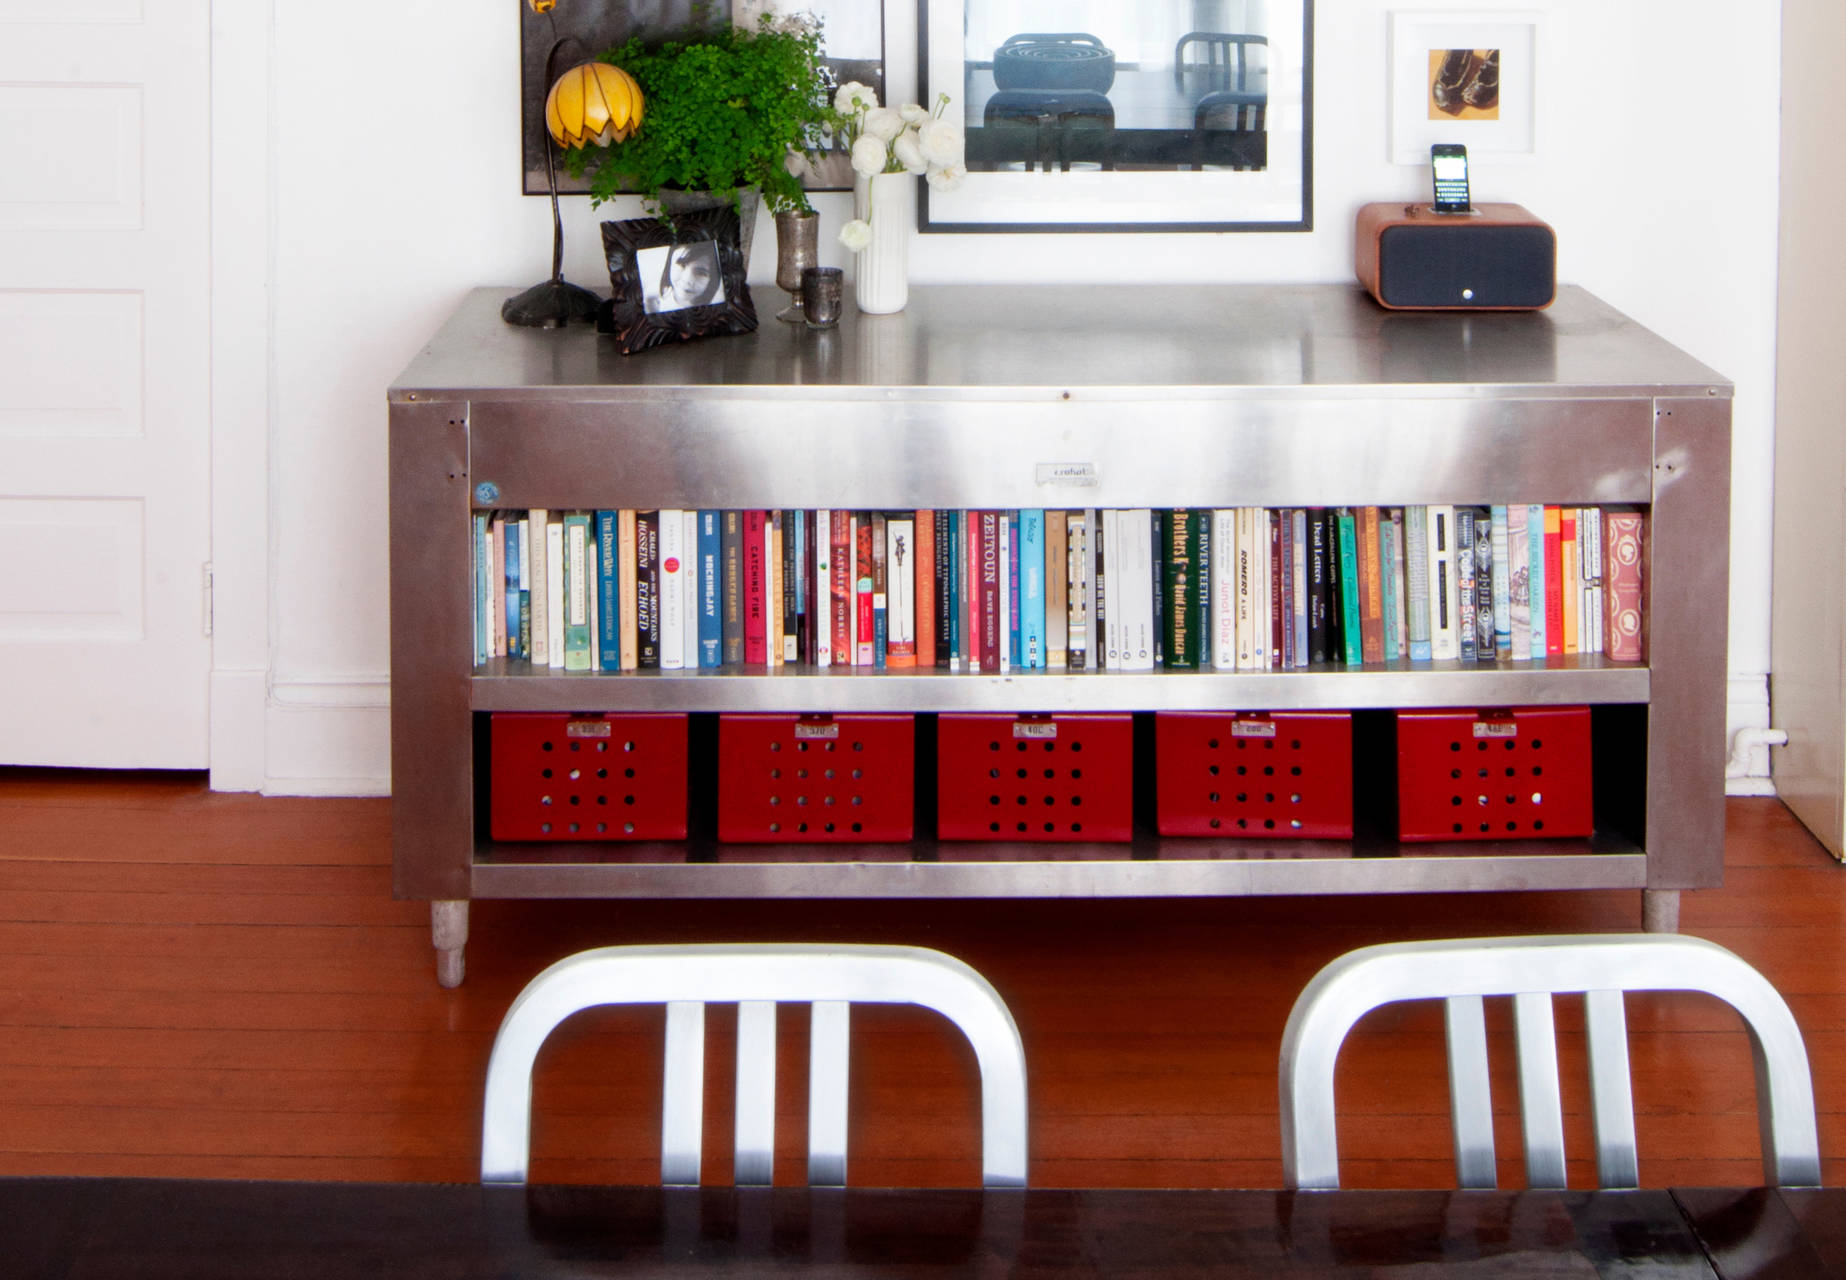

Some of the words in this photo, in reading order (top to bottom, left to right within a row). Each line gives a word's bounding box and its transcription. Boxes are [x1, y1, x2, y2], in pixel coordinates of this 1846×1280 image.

[638, 520, 648, 568] HOSSEINI
[984, 514, 995, 583] ZEITOUN
[1173, 513, 1189, 555] Brothers
[1199, 533, 1208, 566] RIVER
[1313, 521, 1322, 546] Dead
[751, 546, 759, 592] CATCHING
[837, 548, 845, 598] KATHLEEN
[1314, 549, 1322, 583] Letters
[705, 554, 714, 616] MOCKINGJAY
[1174, 584, 1187, 604] David
[1199, 568, 1208, 605] TEETH
[1221, 579, 1232, 614] Junot
[638, 581, 648, 631] ECHOED
[751, 597, 759, 619] FIRE
[1174, 606, 1186, 628] James
[1462, 606, 1475, 642] Street
[1174, 629, 1187, 655] Duncan
